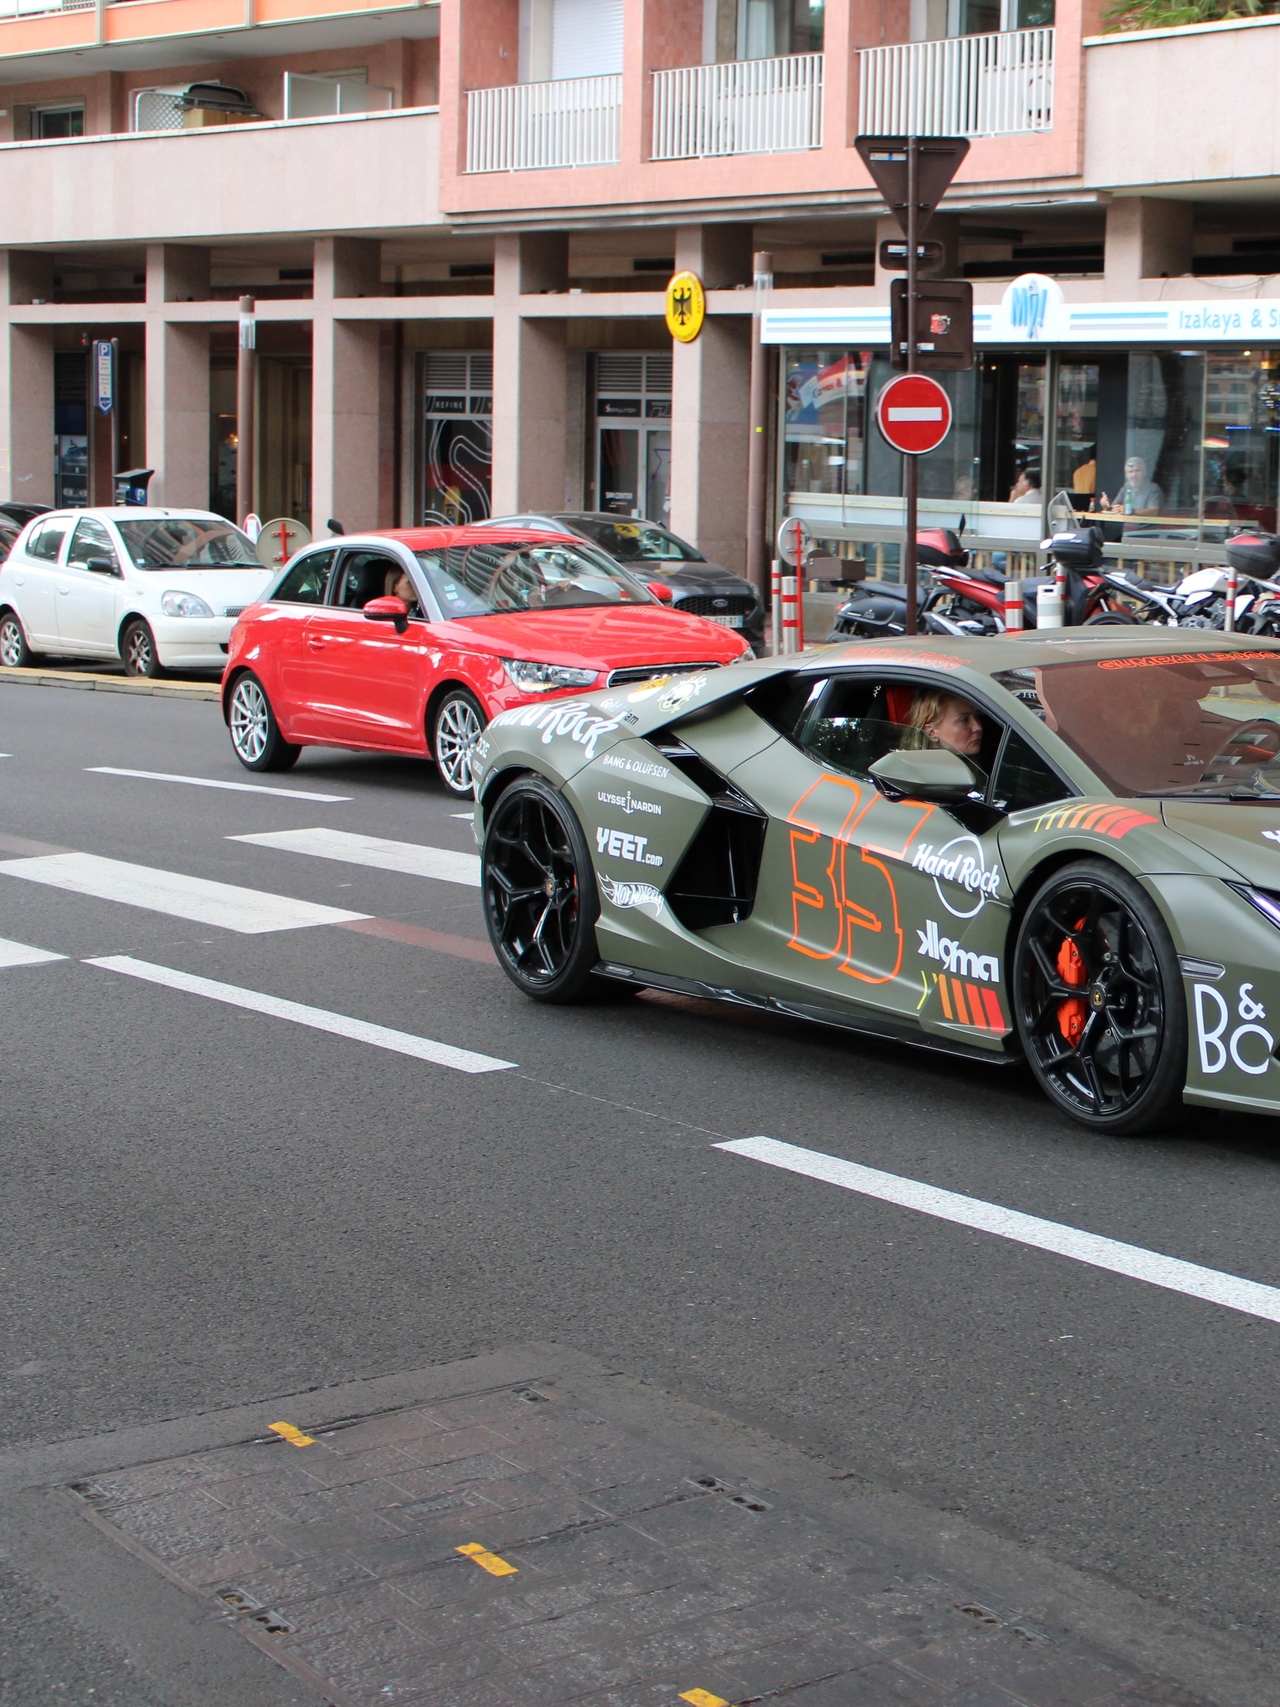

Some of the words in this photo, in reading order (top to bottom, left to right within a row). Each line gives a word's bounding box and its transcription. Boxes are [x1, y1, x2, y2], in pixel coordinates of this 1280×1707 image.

[1179, 308, 1242, 335] Izakaya
[1250, 309, 1263, 328] &
[602, 754, 626, 769] BANG
[625, 759, 632, 770] &
[632, 761, 670, 778] OLUFSEN
[597, 791, 626, 807] ULYSSE
[630, 798, 662, 816] NARDIN
[596, 826, 664, 867] YEET.com
[912, 843, 963, 881] Hard
[957, 856, 1001, 900] Rock
